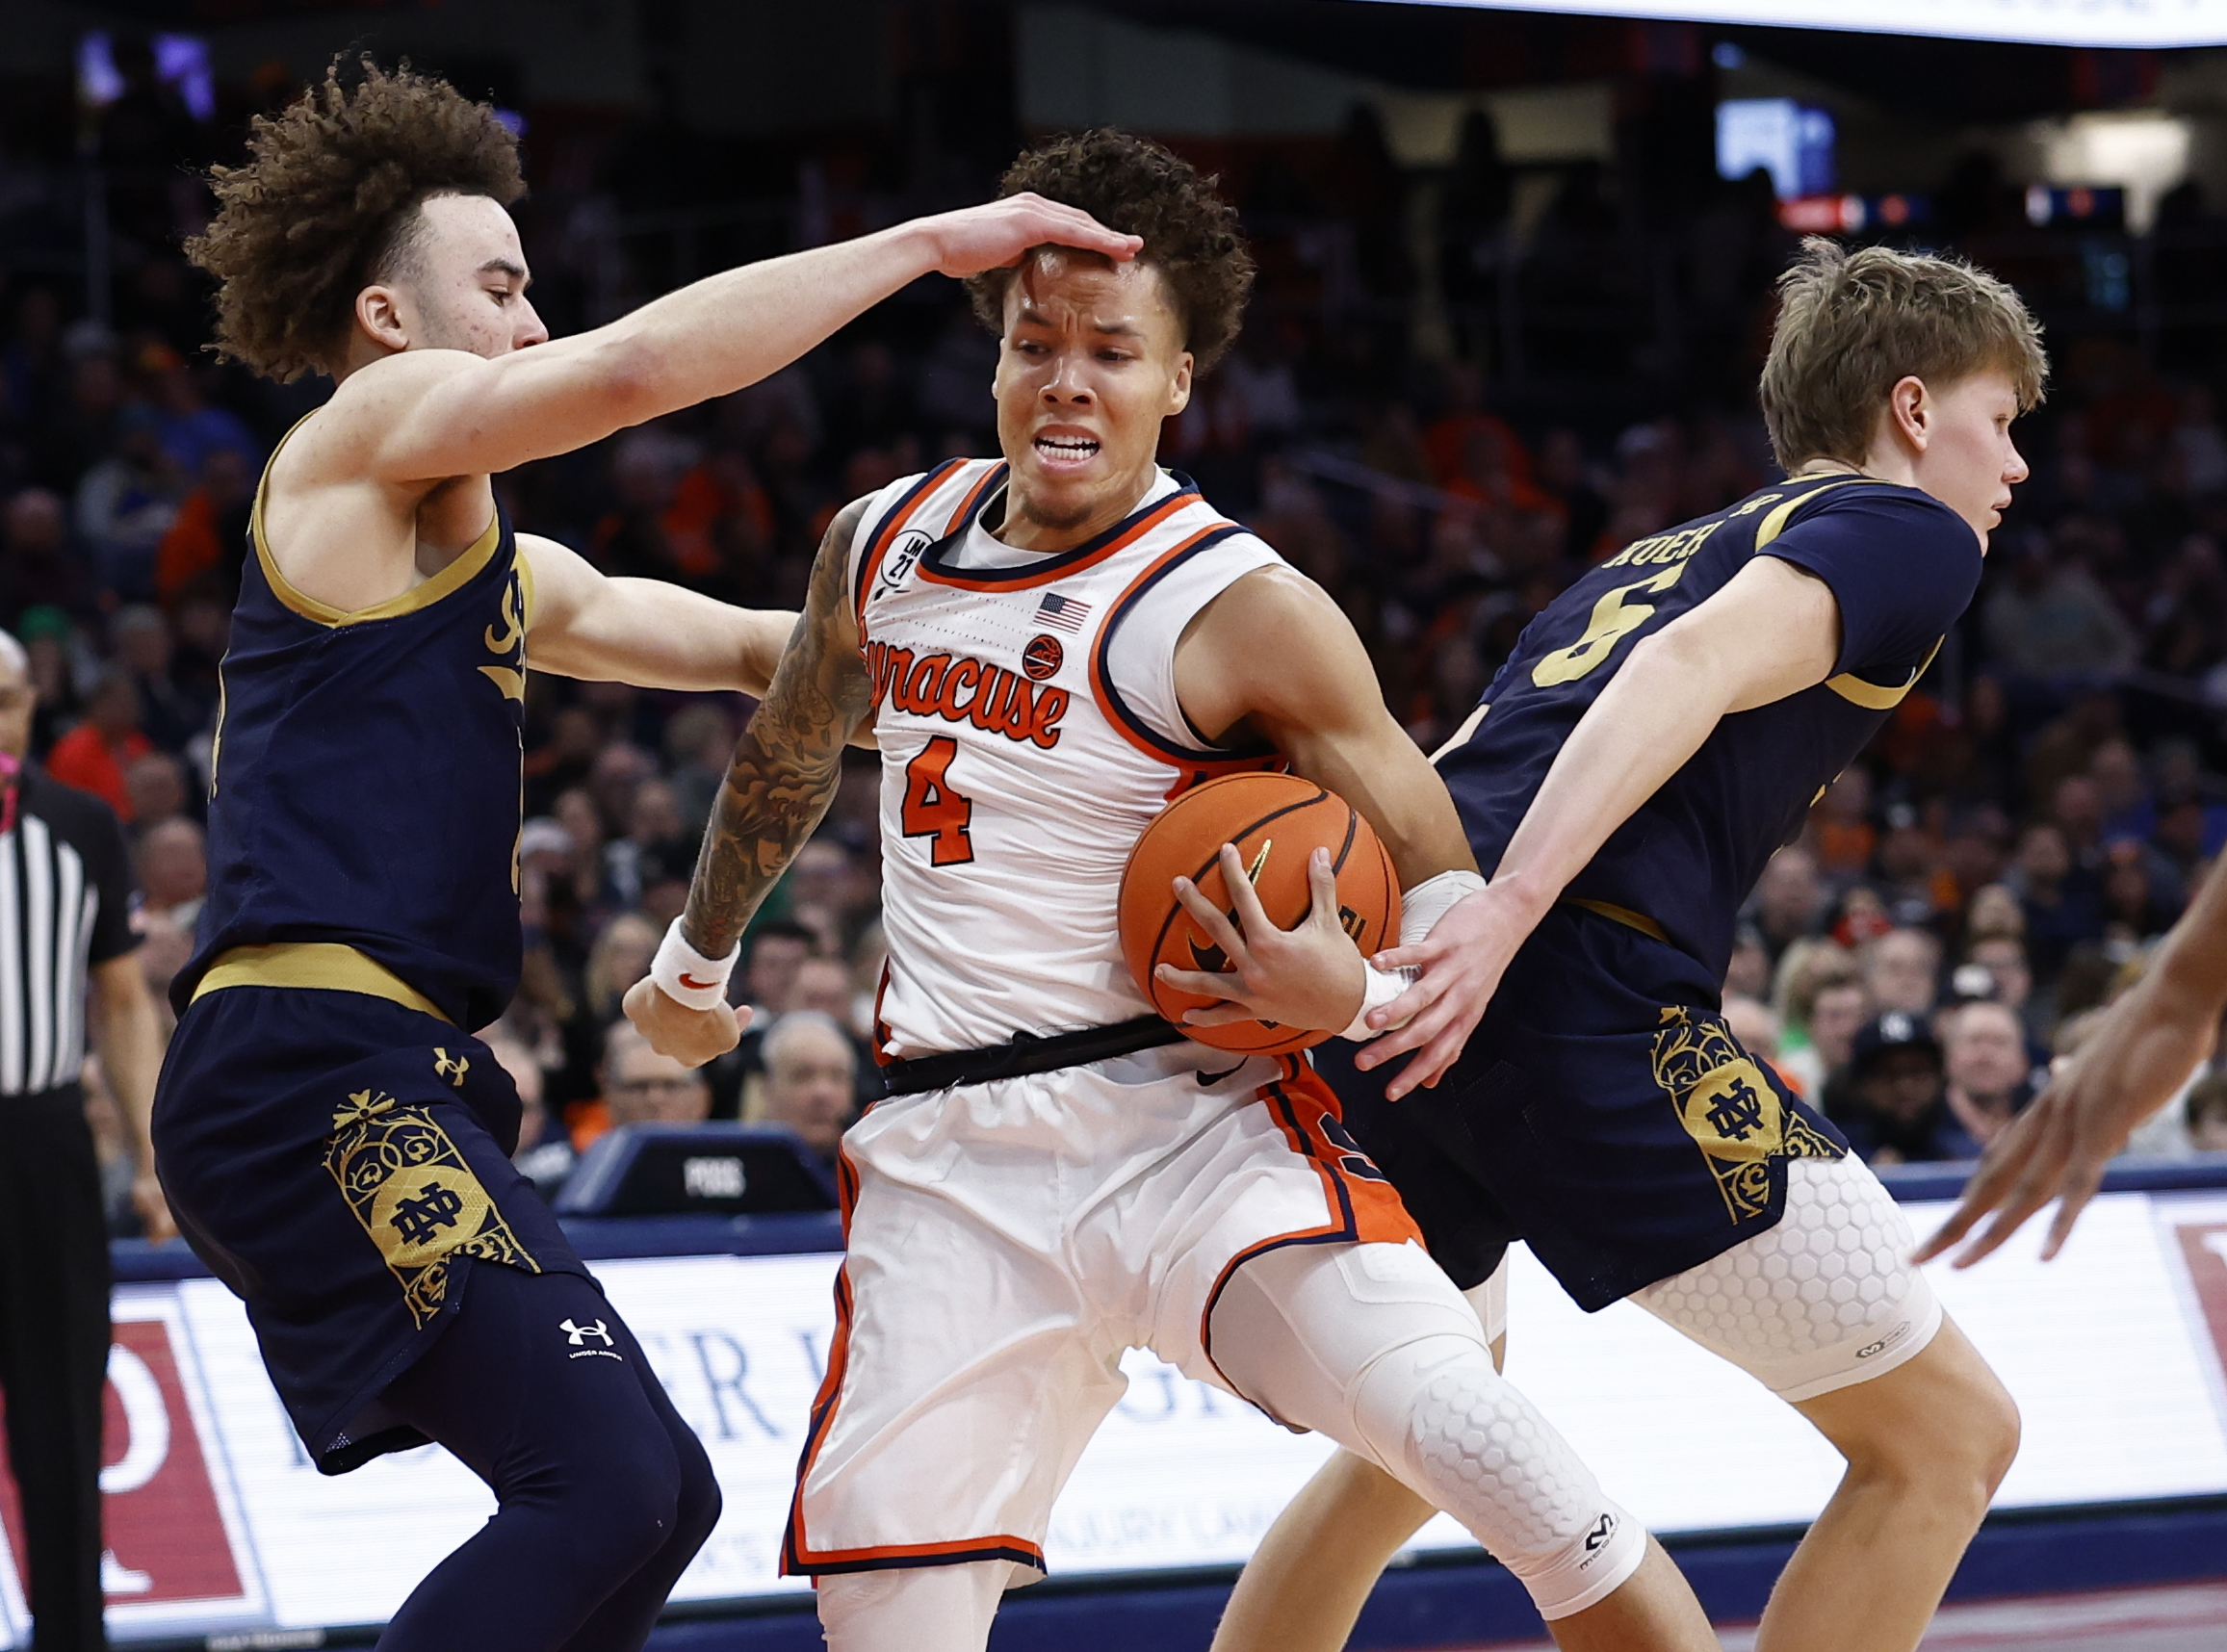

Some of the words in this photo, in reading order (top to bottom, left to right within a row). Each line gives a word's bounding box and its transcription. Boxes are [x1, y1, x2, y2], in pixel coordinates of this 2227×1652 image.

[903, 535, 926, 556] LM
[889, 554, 915, 581] 21
[1530, 558, 1690, 688] 6
[1029, 649, 1060, 664] ACC
[901, 734, 974, 867] 4
[569, 1350, 598, 1359] UNDER
